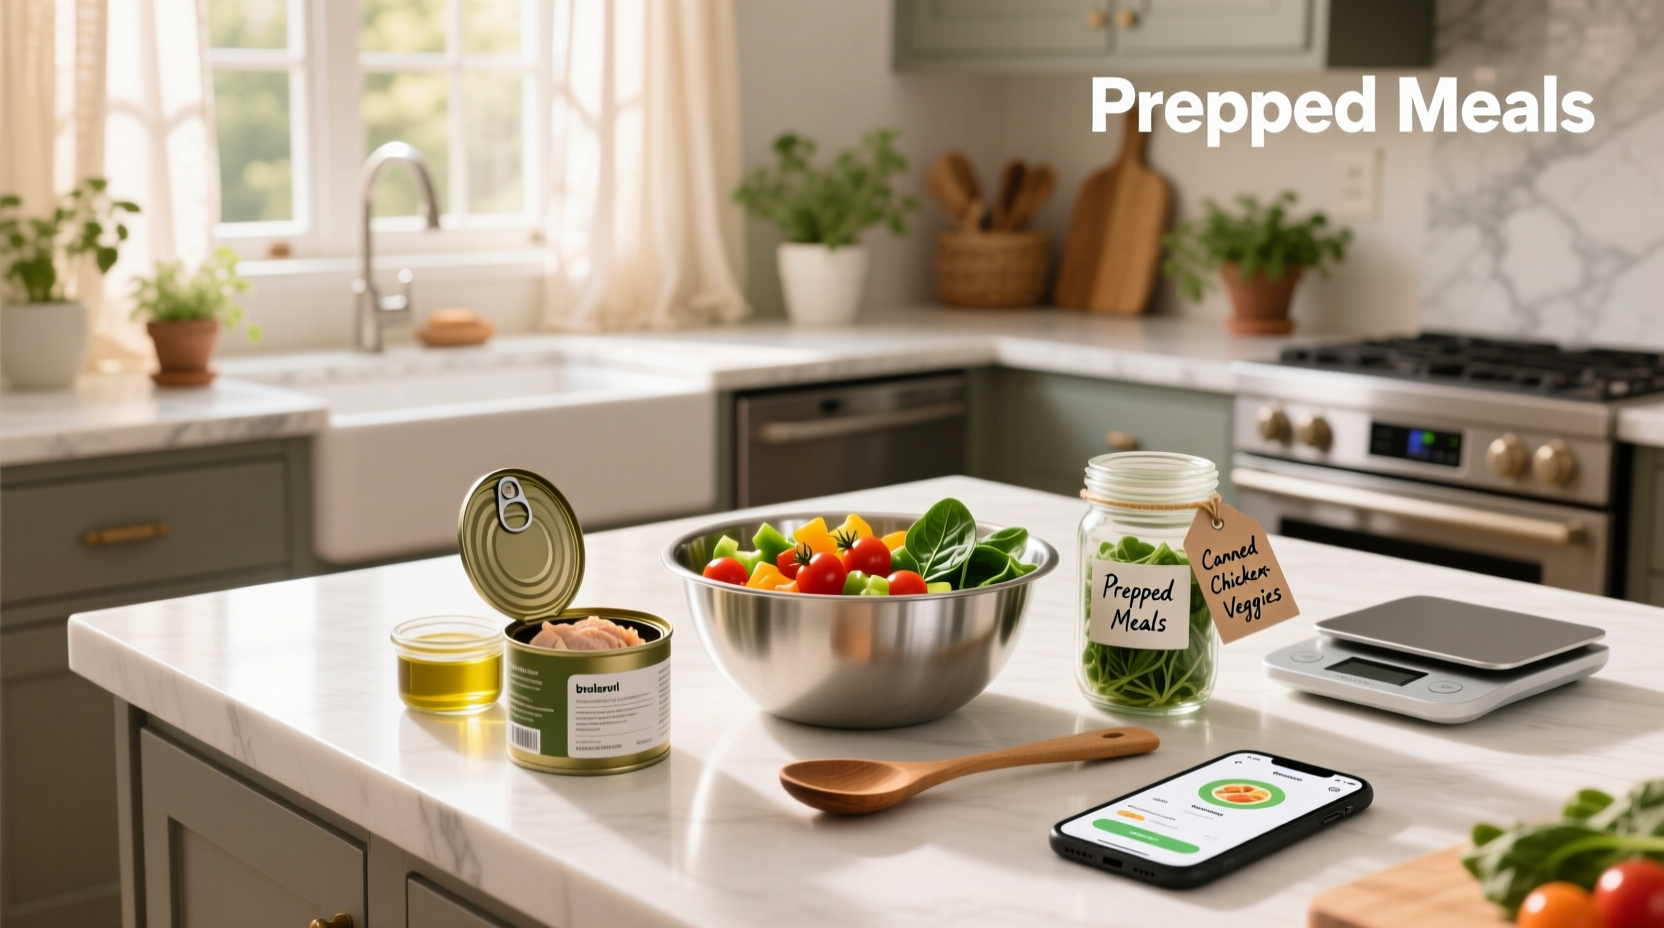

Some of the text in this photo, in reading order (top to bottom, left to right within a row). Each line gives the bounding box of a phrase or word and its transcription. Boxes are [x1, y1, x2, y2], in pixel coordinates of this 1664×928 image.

[1202, 535, 1258, 570] Canned
[1103, 573, 1174, 609] Prepped
[1223, 588, 1282, 622] Veggies
[1111, 608, 1166, 632] Meals
